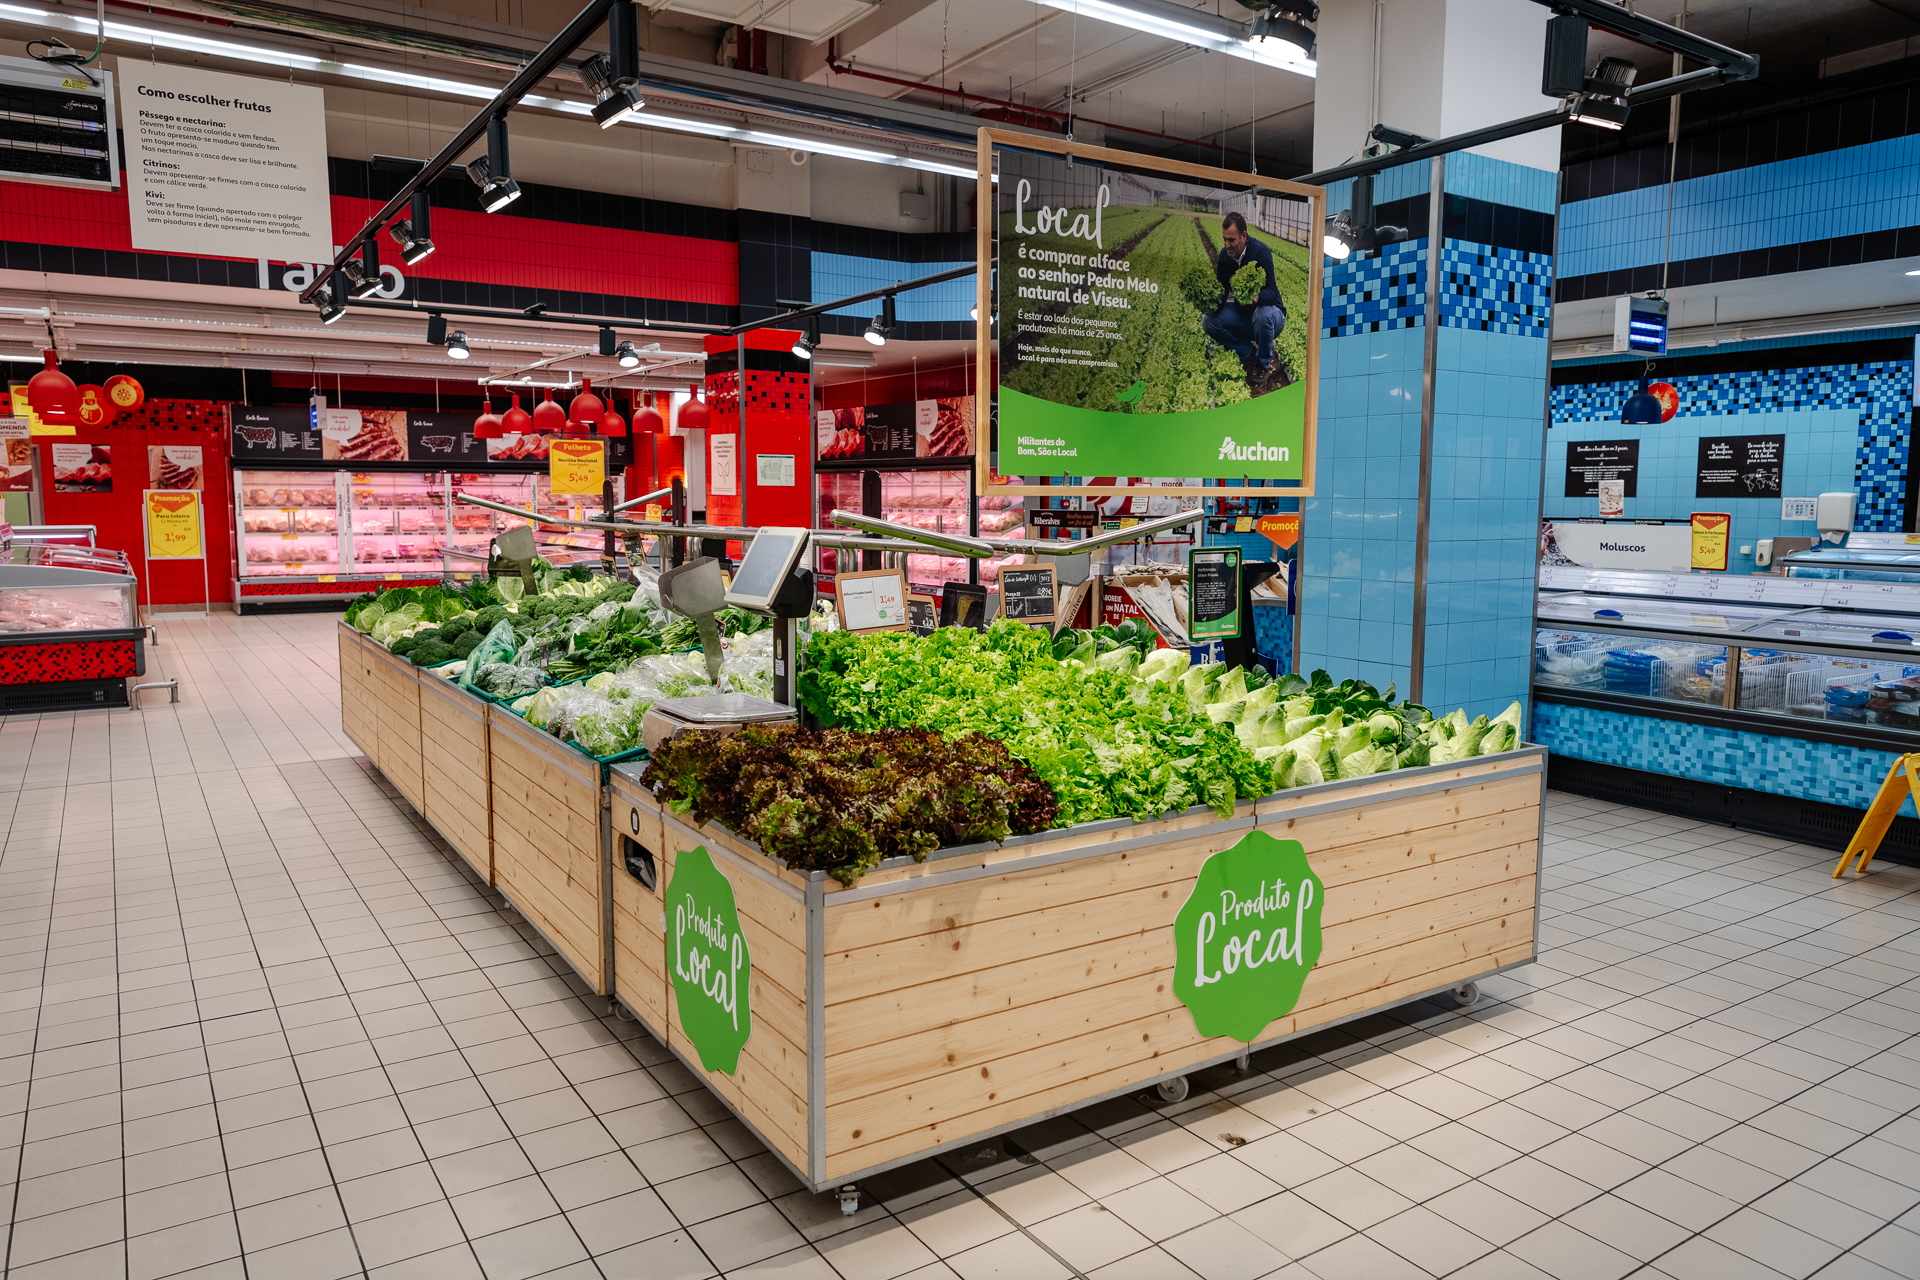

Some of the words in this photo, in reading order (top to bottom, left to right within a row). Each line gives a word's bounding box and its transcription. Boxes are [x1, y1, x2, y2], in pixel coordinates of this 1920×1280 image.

[138, 85, 175, 99] Como
[178, 93, 231, 107] escolher
[234, 98, 272, 113] frutas
[139, 110, 174, 122] Pêssego
[182, 117, 226, 128] nectarina:
[140, 120, 164, 128] Devem
[165, 122, 175, 130] ter
[203, 128, 231, 137] colorida
[253, 134, 277, 143] fendas.
[148, 129, 166, 137] fruto
[167, 132, 212, 143] apresenta-se
[213, 138, 239, 146] maduro
[240, 141, 265, 149] quando
[154, 138, 175, 146] toque
[176, 141, 198, 149] macio.
[143, 159, 180, 169] Citrinos:
[157, 147, 193, 157] nectarinas
[267, 160, 298, 169] brilhante.
[143, 168, 167, 176] Devem
[169, 171, 216, 182] apresentar-se
[217, 176, 238, 184] firmes
[280, 184, 307, 192] colorida
[166, 179, 186, 187] cálice
[145, 191, 165, 199] Kivi:
[172, 210, 193, 218] forma
[195, 213, 220, 221] inicial),
[268, 221, 301, 229] enrugado,
[196, 205, 225, 213] (quando
[226, 208, 256, 216] apertado
[1015, 178, 1110, 250] Local
[163, 219, 197, 227] pisaduras
[220, 224, 265, 233] apresentar-se
[282, 229, 311, 238] formado.
[1018, 242, 1027, 259] é
[1028, 248, 1087, 268] comprar
[1088, 253, 1131, 272] alface
[1018, 266, 1036, 279] ao
[1038, 267, 1085, 285] senhor
[1087, 271, 1125, 290] Pedro
[1127, 276, 1159, 294] Melo
[1018, 285, 1071, 303] natural
[1072, 289, 1090, 305] de
[1091, 290, 1132, 309] Viseu.
[1017, 308, 1023, 319] É
[1024, 312, 1043, 321] estar
[1043, 314, 1053, 322] ao
[1054, 314, 1070, 324] lado
[1071, 316, 1084, 325] dos
[1084, 318, 1118, 328] pequenos
[1017, 323, 1057, 334] produtores
[1057, 326, 1067, 335] há
[1068, 327, 1085, 337] mais
[1086, 329, 1095, 338] de
[1095, 330, 1104, 338] 25
[1105, 332, 1124, 340] anos.
[1017, 343, 1034, 352] Hoje,
[1035, 345, 1050, 353] mais
[1051, 346, 1059, 354] do
[1060, 347, 1071, 355] que
[1072, 349, 1093, 357] nunca,
[1017, 354, 1035, 362] Local
[1036, 354, 1040, 362] é
[1040, 356, 1055, 364] para
[1055, 356, 1067, 364] nós
[1078, 359, 1119, 368] compromisso.
[563, 443, 591, 451] Folheto
[1017, 436, 1055, 446] Militantes
[1055, 437, 1066, 446] do
[1218, 436, 1289, 461] Auchan
[1017, 446, 1037, 457] Bom,
[1037, 447, 1052, 456] São
[1057, 447, 1078, 457] Local
[154, 495, 190, 503] Promoção
[1033, 516, 1061, 525] Riberalves
[1261, 520, 1299, 533] Promoçã
[1599, 542, 1646, 553] Moluscos
[1064, 594, 1083, 627] iberalves
[1114, 603, 1139, 615] NATAL
[1220, 878, 1290, 926] Produto
[686, 893, 727, 952] Produto
[1194, 878, 1314, 987] Local
[676, 904, 743, 1032] Local
